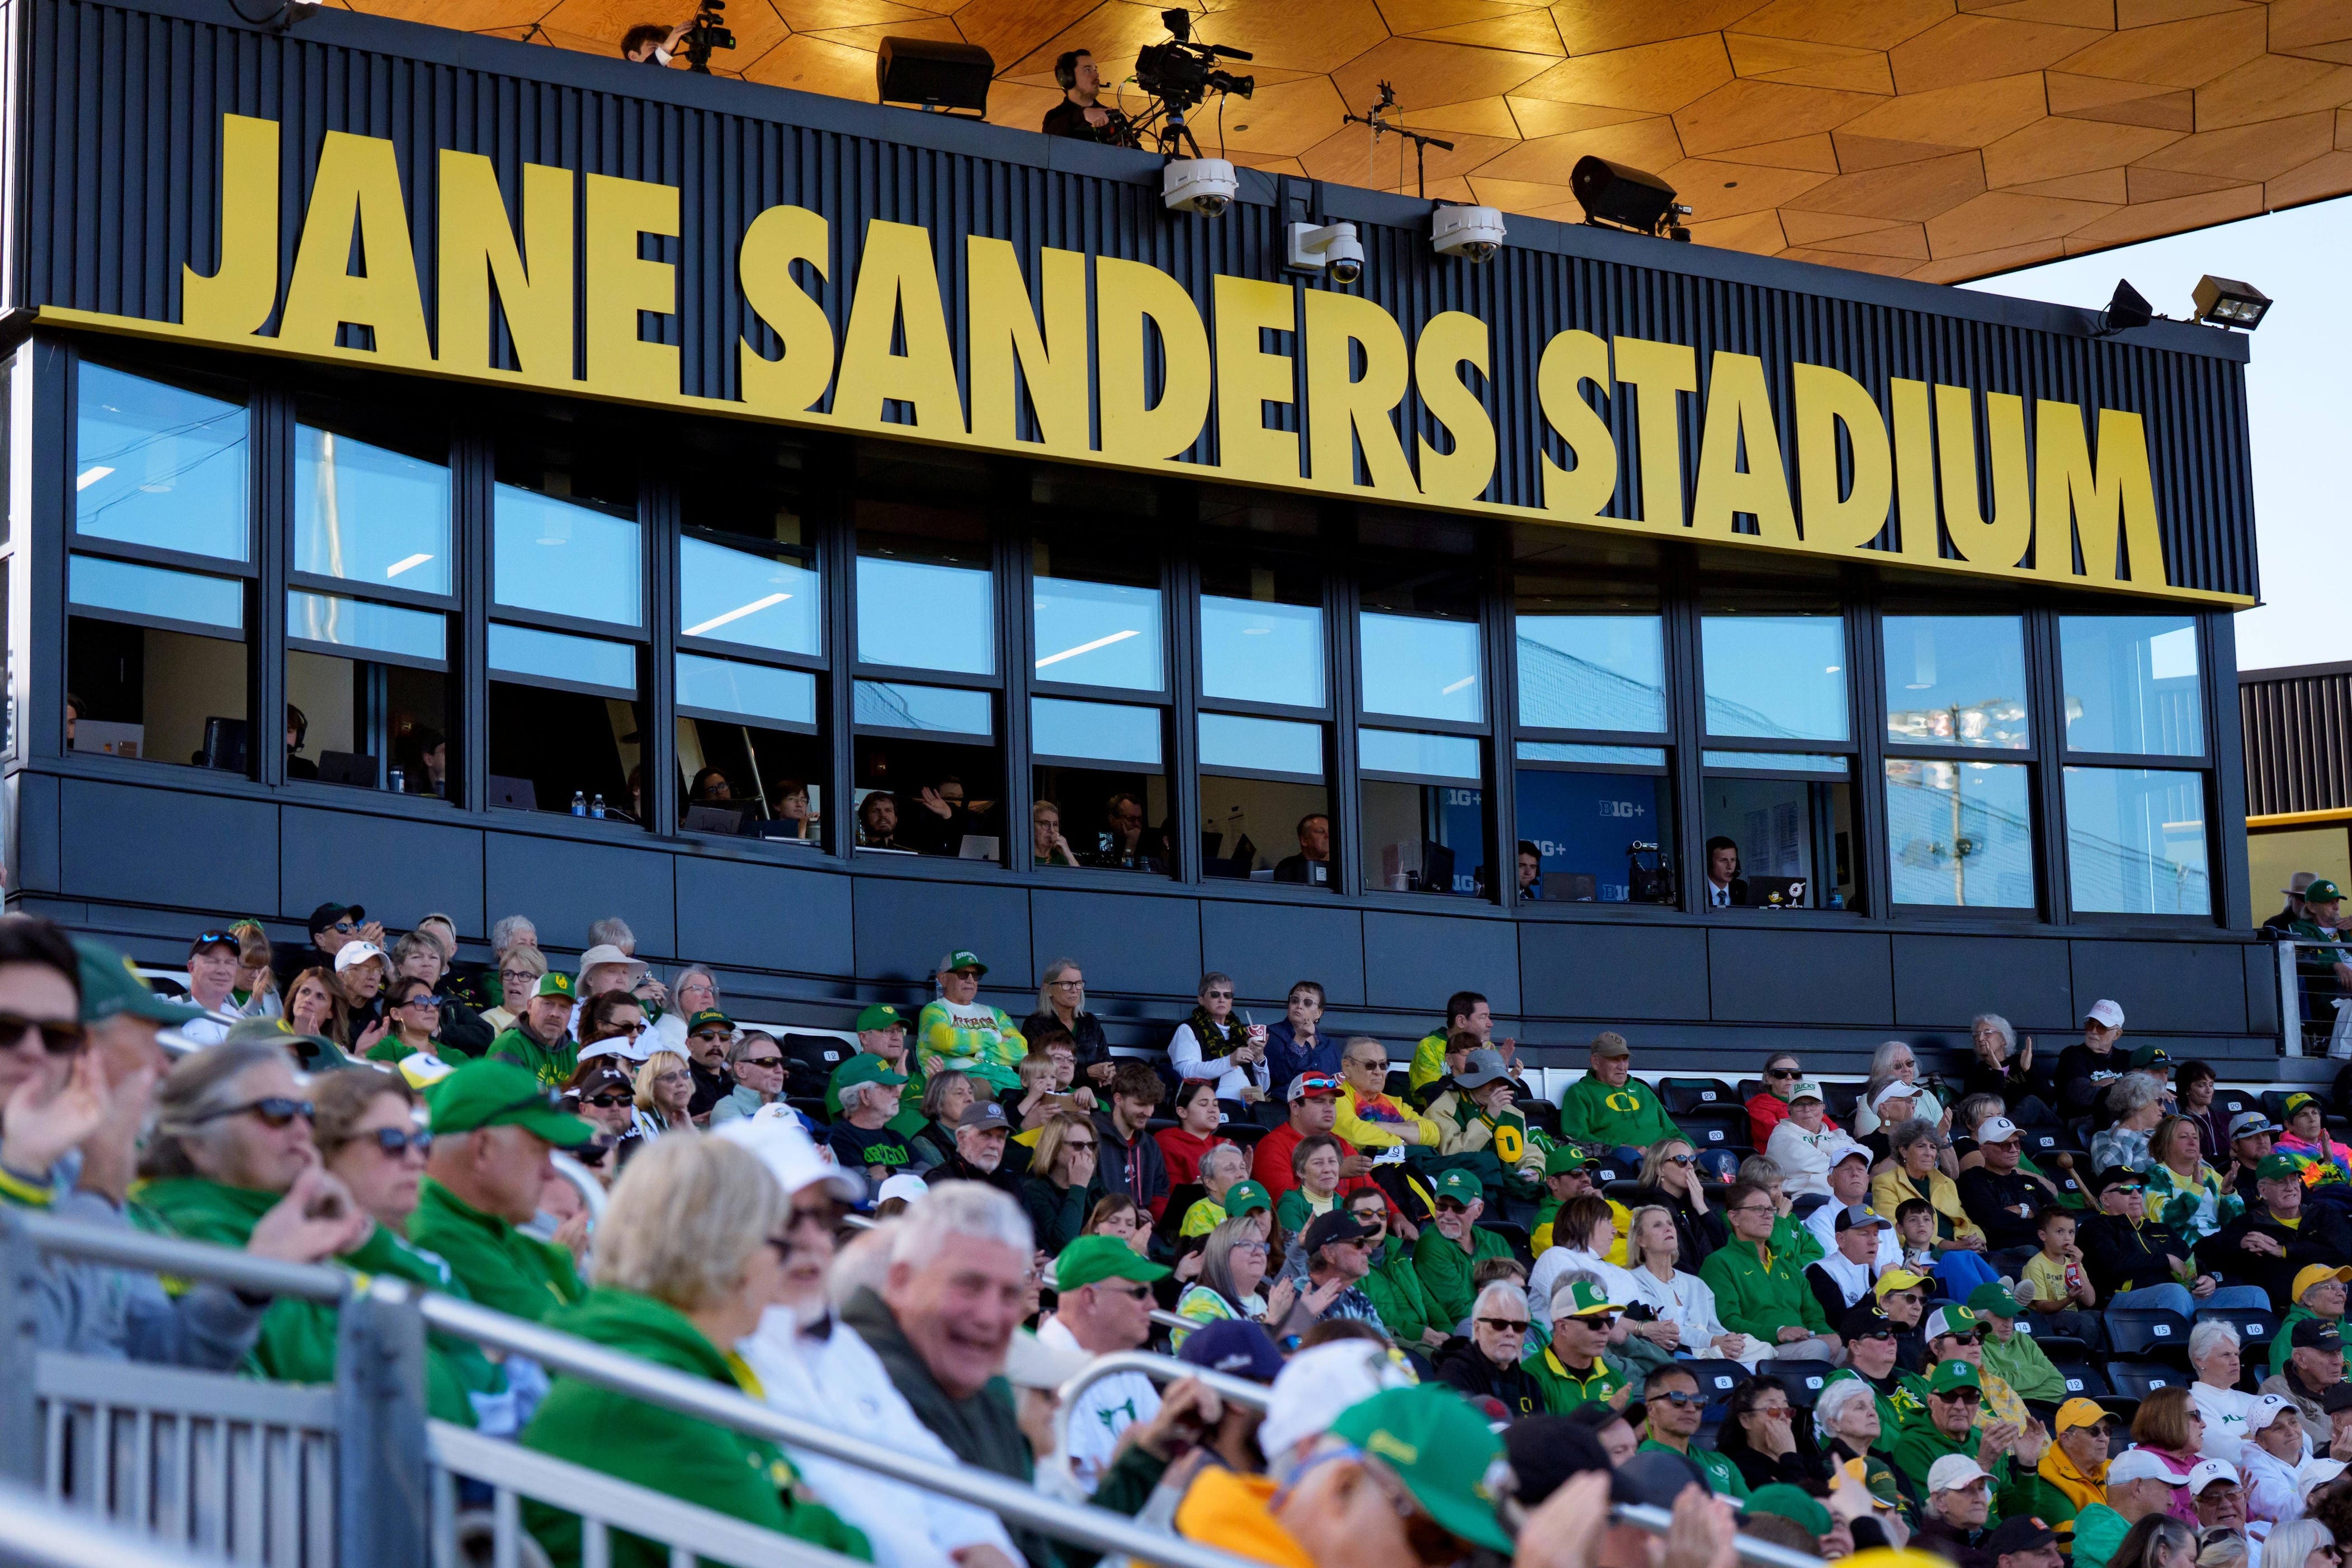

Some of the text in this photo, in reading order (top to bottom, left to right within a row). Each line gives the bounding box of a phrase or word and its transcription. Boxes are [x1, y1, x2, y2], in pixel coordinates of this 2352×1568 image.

[183, 113, 2167, 587] JANE SANDERS STADIUM
[1794, 1083, 1816, 1092] DUCKS
[1605, 1092, 1640, 1112] O
[1997, 1119, 2010, 1128] O
[1570, 1148, 1583, 1159] O
[1958, 1306, 1975, 1319] O
[2069, 1381, 2081, 1389] 12
[2264, 1396, 2278, 1405] O
